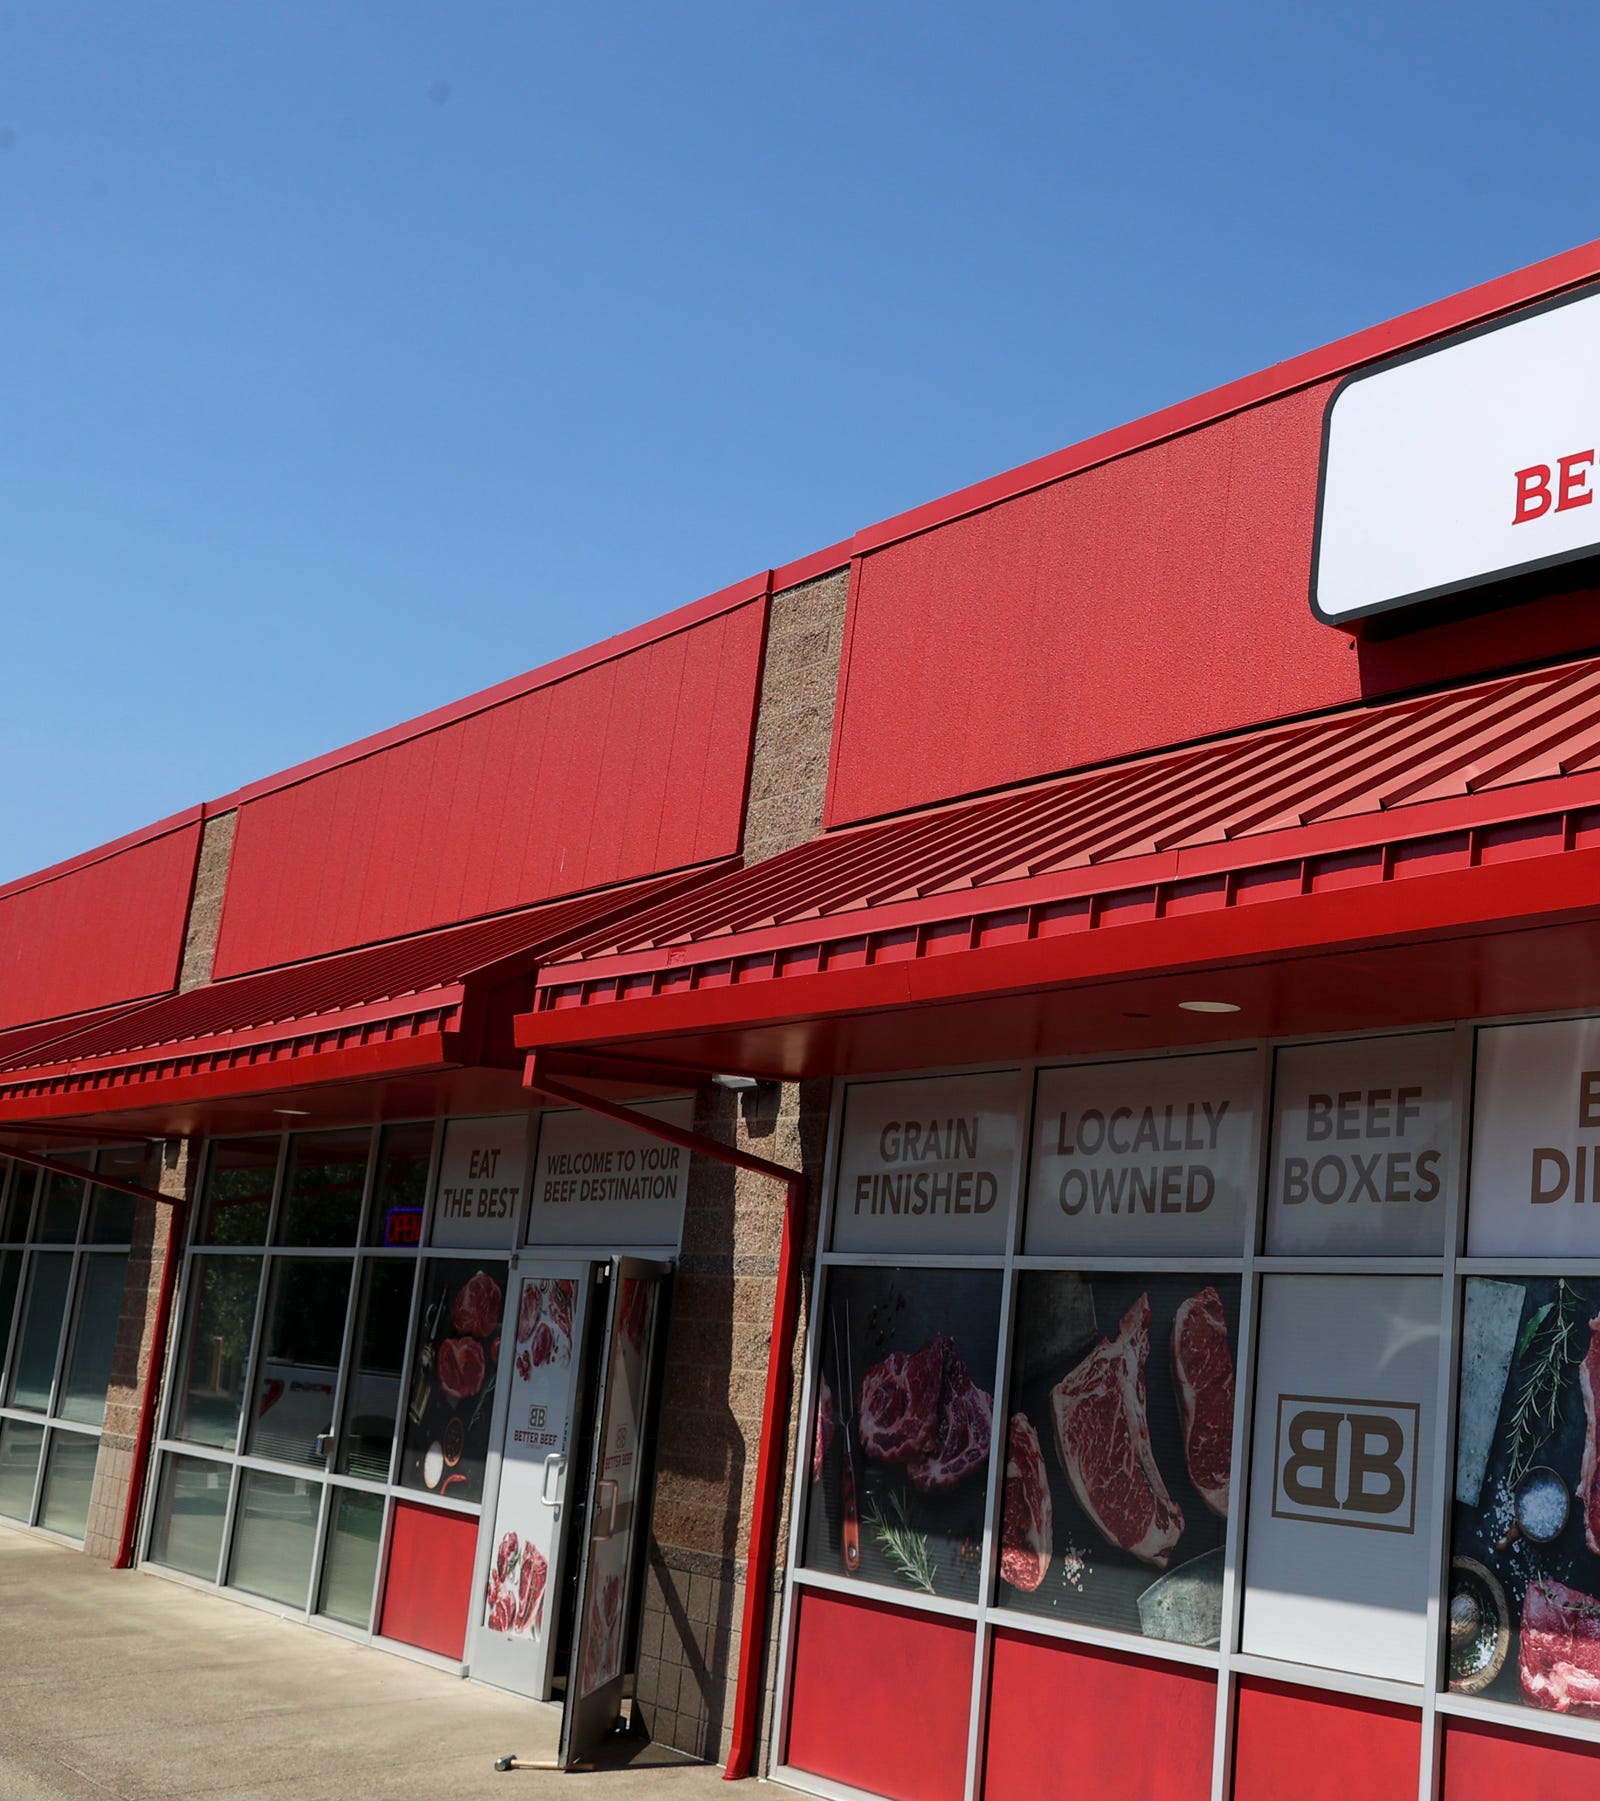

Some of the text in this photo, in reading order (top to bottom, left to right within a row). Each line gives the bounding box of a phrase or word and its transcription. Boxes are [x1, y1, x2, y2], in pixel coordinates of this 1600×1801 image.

[1057, 1100, 1230, 1156] LOCALLY
[1306, 1087, 1422, 1142] BEEF
[547, 1147, 681, 1176] WELCOME TO YOUR
[880, 1117, 979, 1162] GRAIN
[468, 1149, 501, 1179] EAT
[1282, 1149, 1441, 1205] BOXES
[443, 1188, 519, 1218] THE BEST
[544, 1175, 678, 1203] BEEF DESTINATION
[854, 1171, 998, 1215] FINISHED
[1058, 1165, 1215, 1216] OWNED
[514, 1430, 558, 1446] BETTER BEEF
